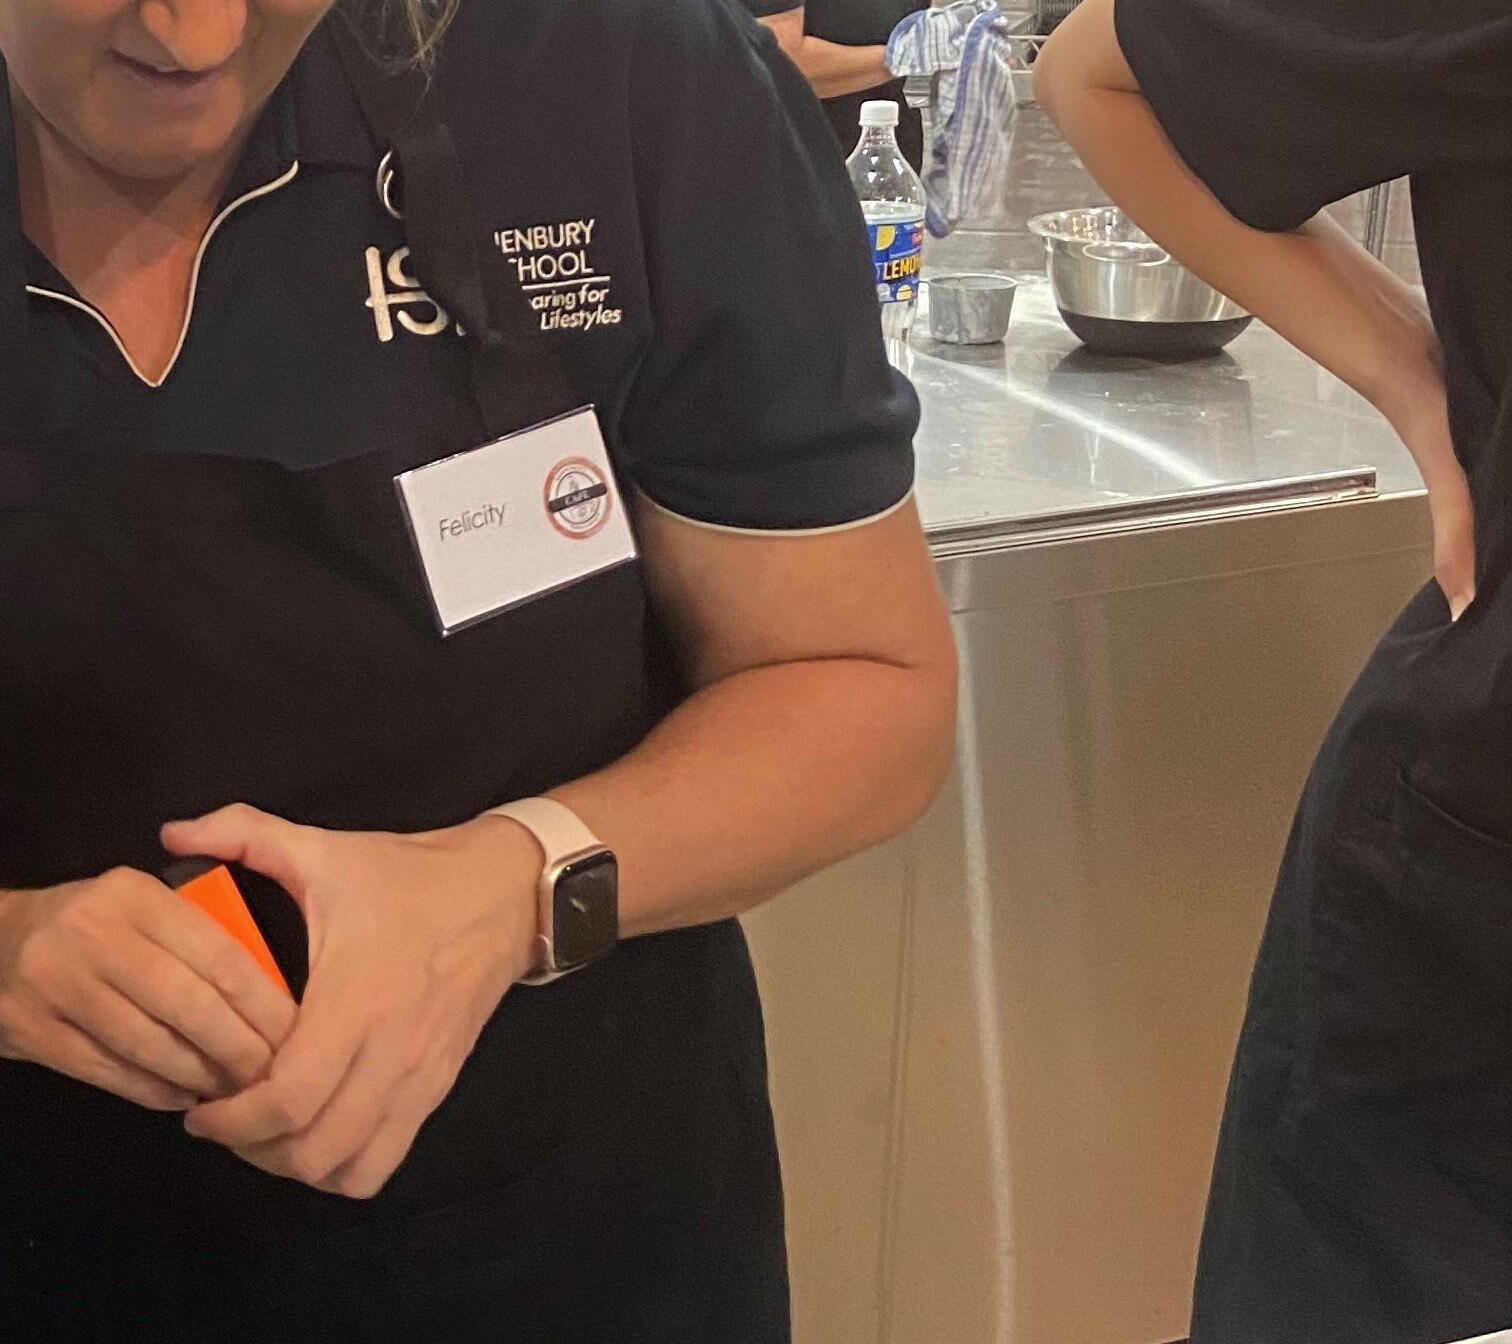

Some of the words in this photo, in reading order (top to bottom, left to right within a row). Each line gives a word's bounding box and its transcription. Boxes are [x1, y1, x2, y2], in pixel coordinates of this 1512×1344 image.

[508, 250, 594, 281] HOOL
[529, 290, 576, 310] aring
[578, 283, 610, 304] for
[540, 304, 622, 331] Lifestyles
[438, 503, 507, 542] Felicity
